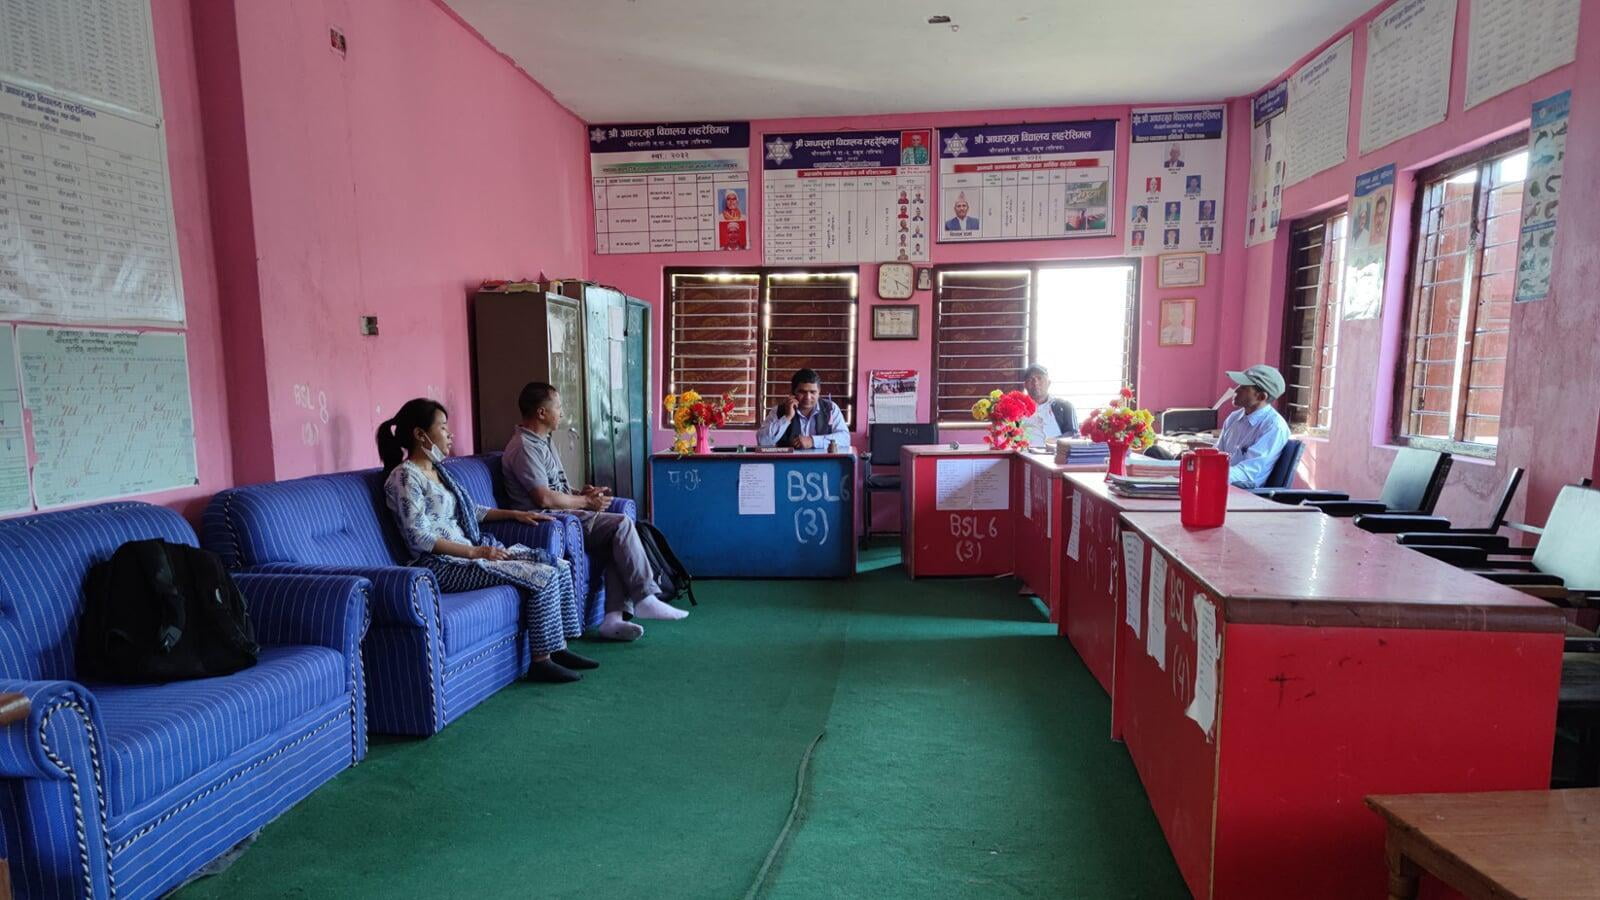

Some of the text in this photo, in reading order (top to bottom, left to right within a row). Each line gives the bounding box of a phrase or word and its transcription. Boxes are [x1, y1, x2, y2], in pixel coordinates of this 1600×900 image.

[608, 128, 618, 138] श्री
[656, 126, 686, 136] विद्यालय
[795, 140, 803, 149] श्री
[974, 134, 984, 144] श्री
[1021, 131, 1050, 142] विद्यालय
[787, 470, 840, 502] BSL
[794, 506, 829, 546] (3)
[950, 513, 998, 540] BSL 6
[956, 540, 982, 564] (3)
[1170, 568, 1188, 632] BSL
